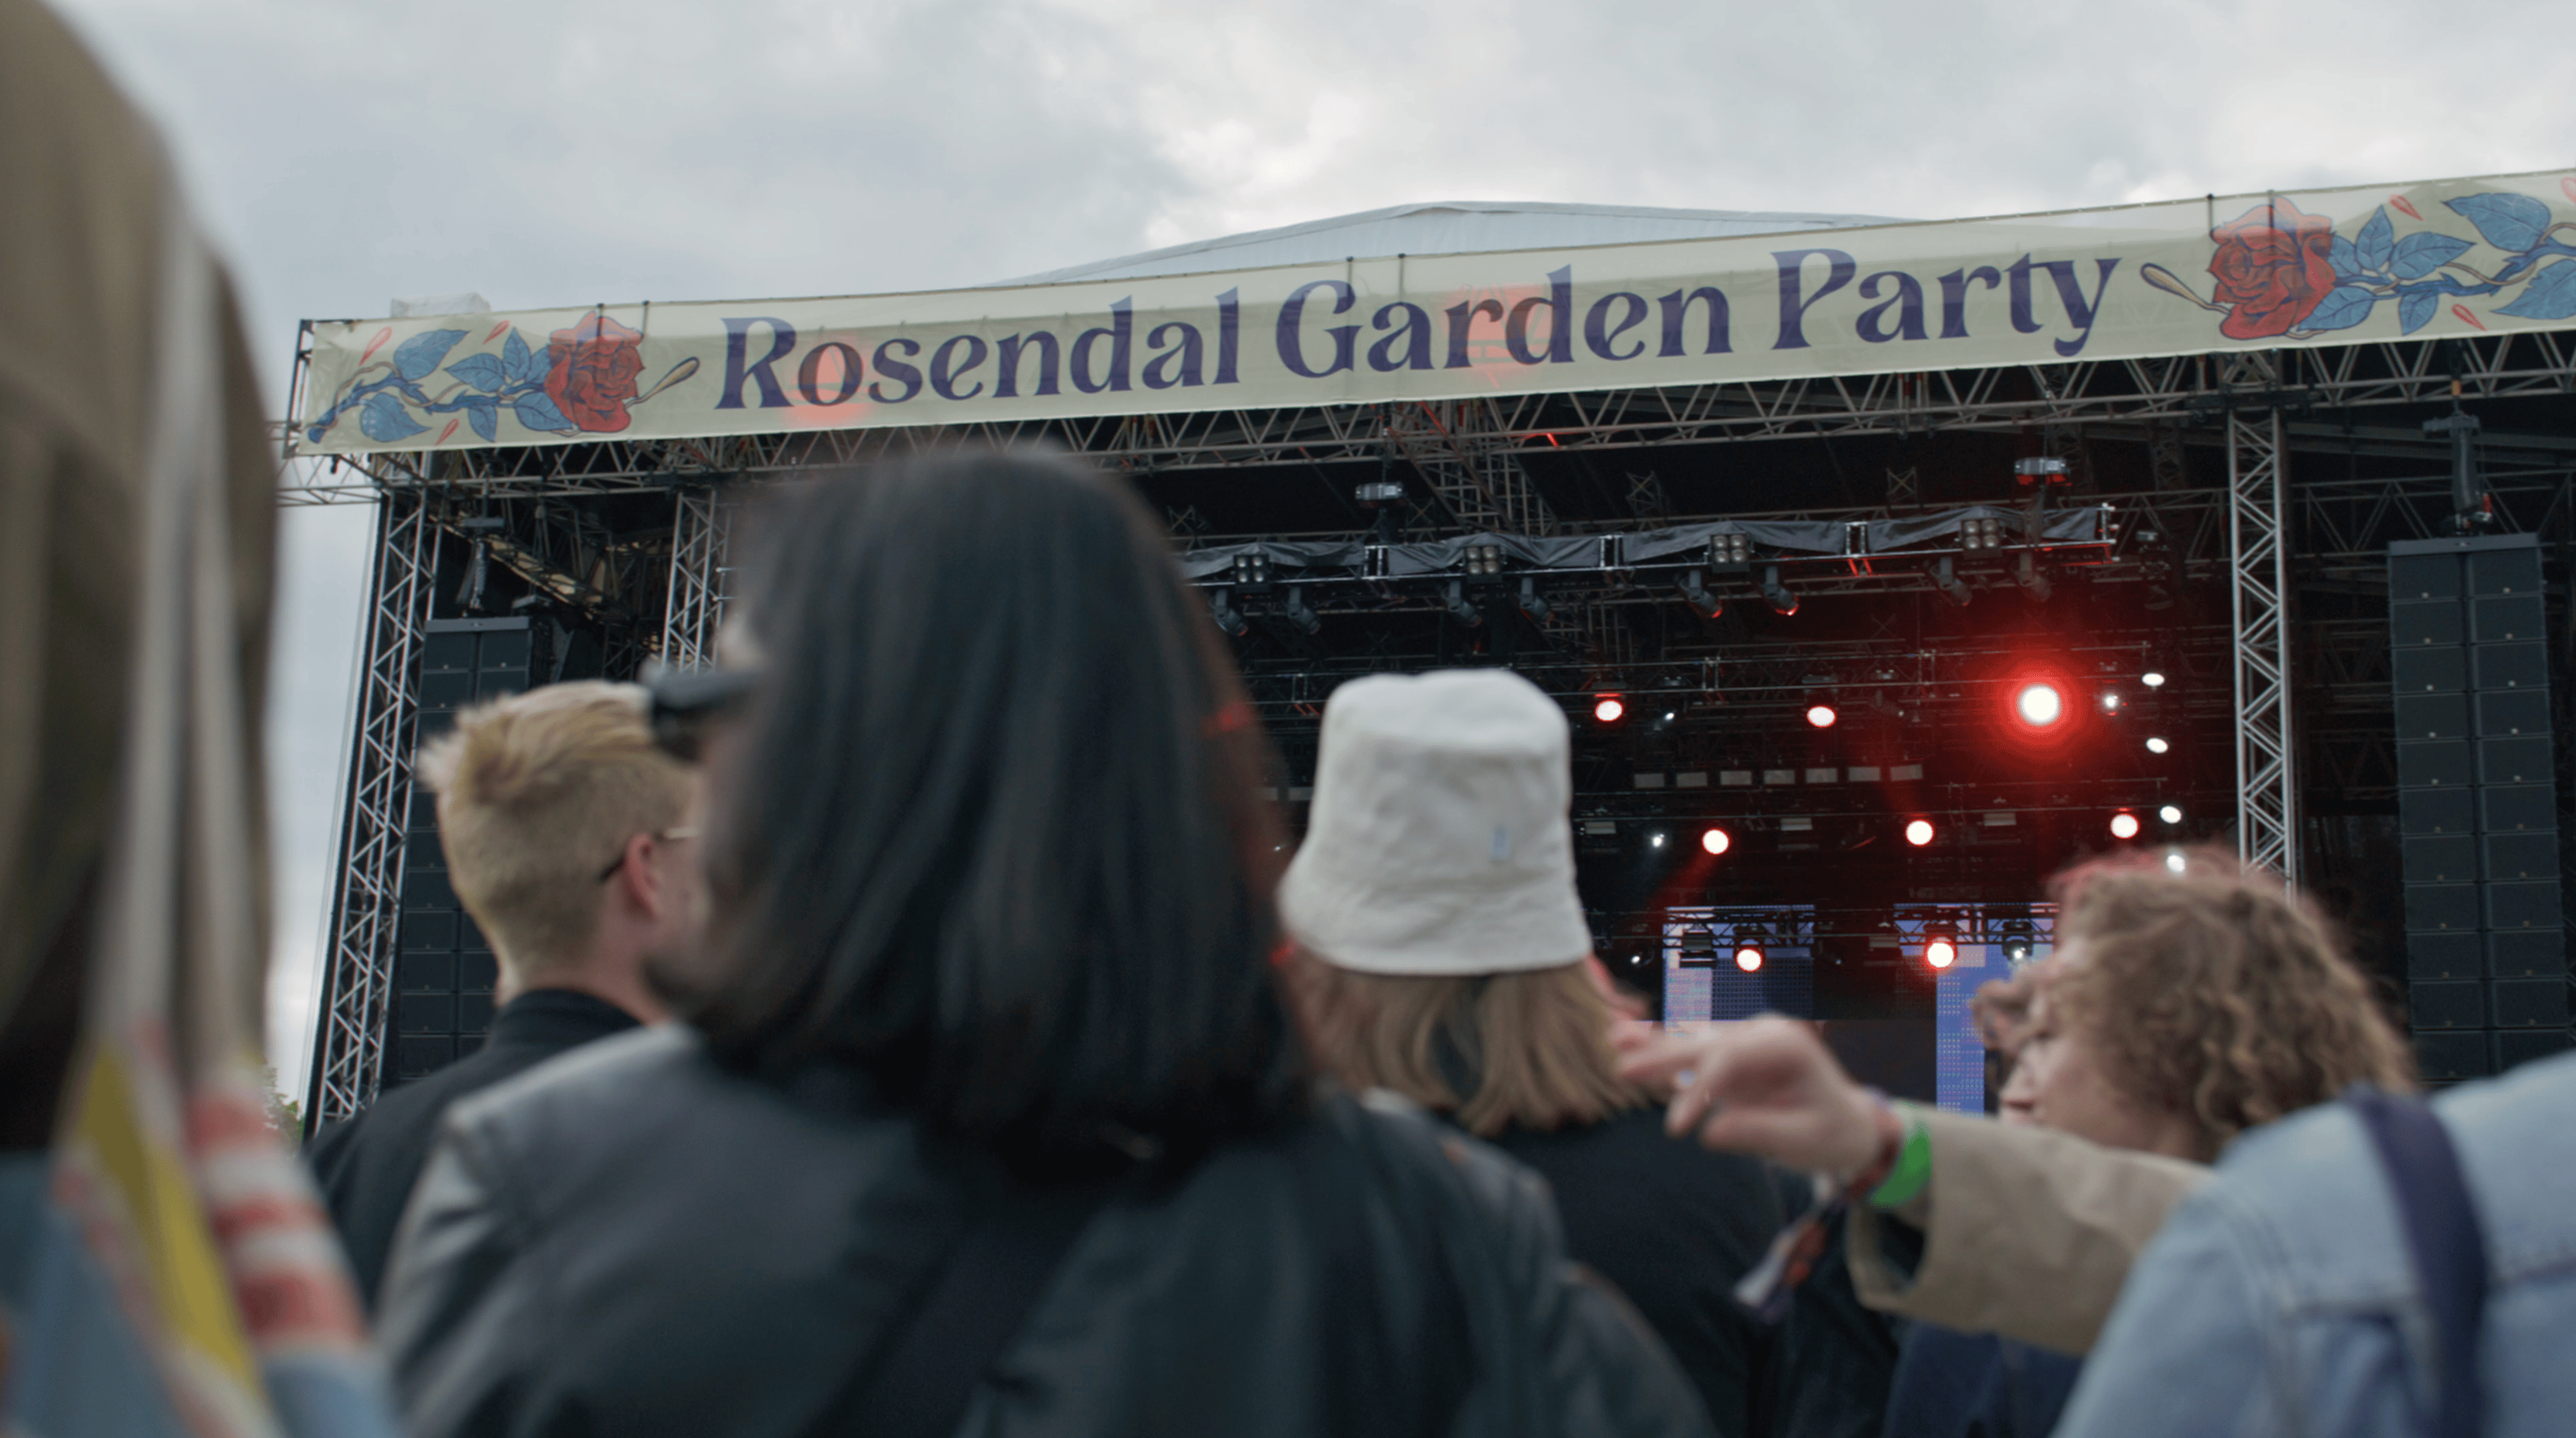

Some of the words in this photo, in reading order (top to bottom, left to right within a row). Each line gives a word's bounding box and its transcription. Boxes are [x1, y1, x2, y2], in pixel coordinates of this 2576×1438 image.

[714, 287, 1240, 409] Rosendal
[1276, 264, 1733, 378] Garden
[1771, 249, 2122, 356] Party
